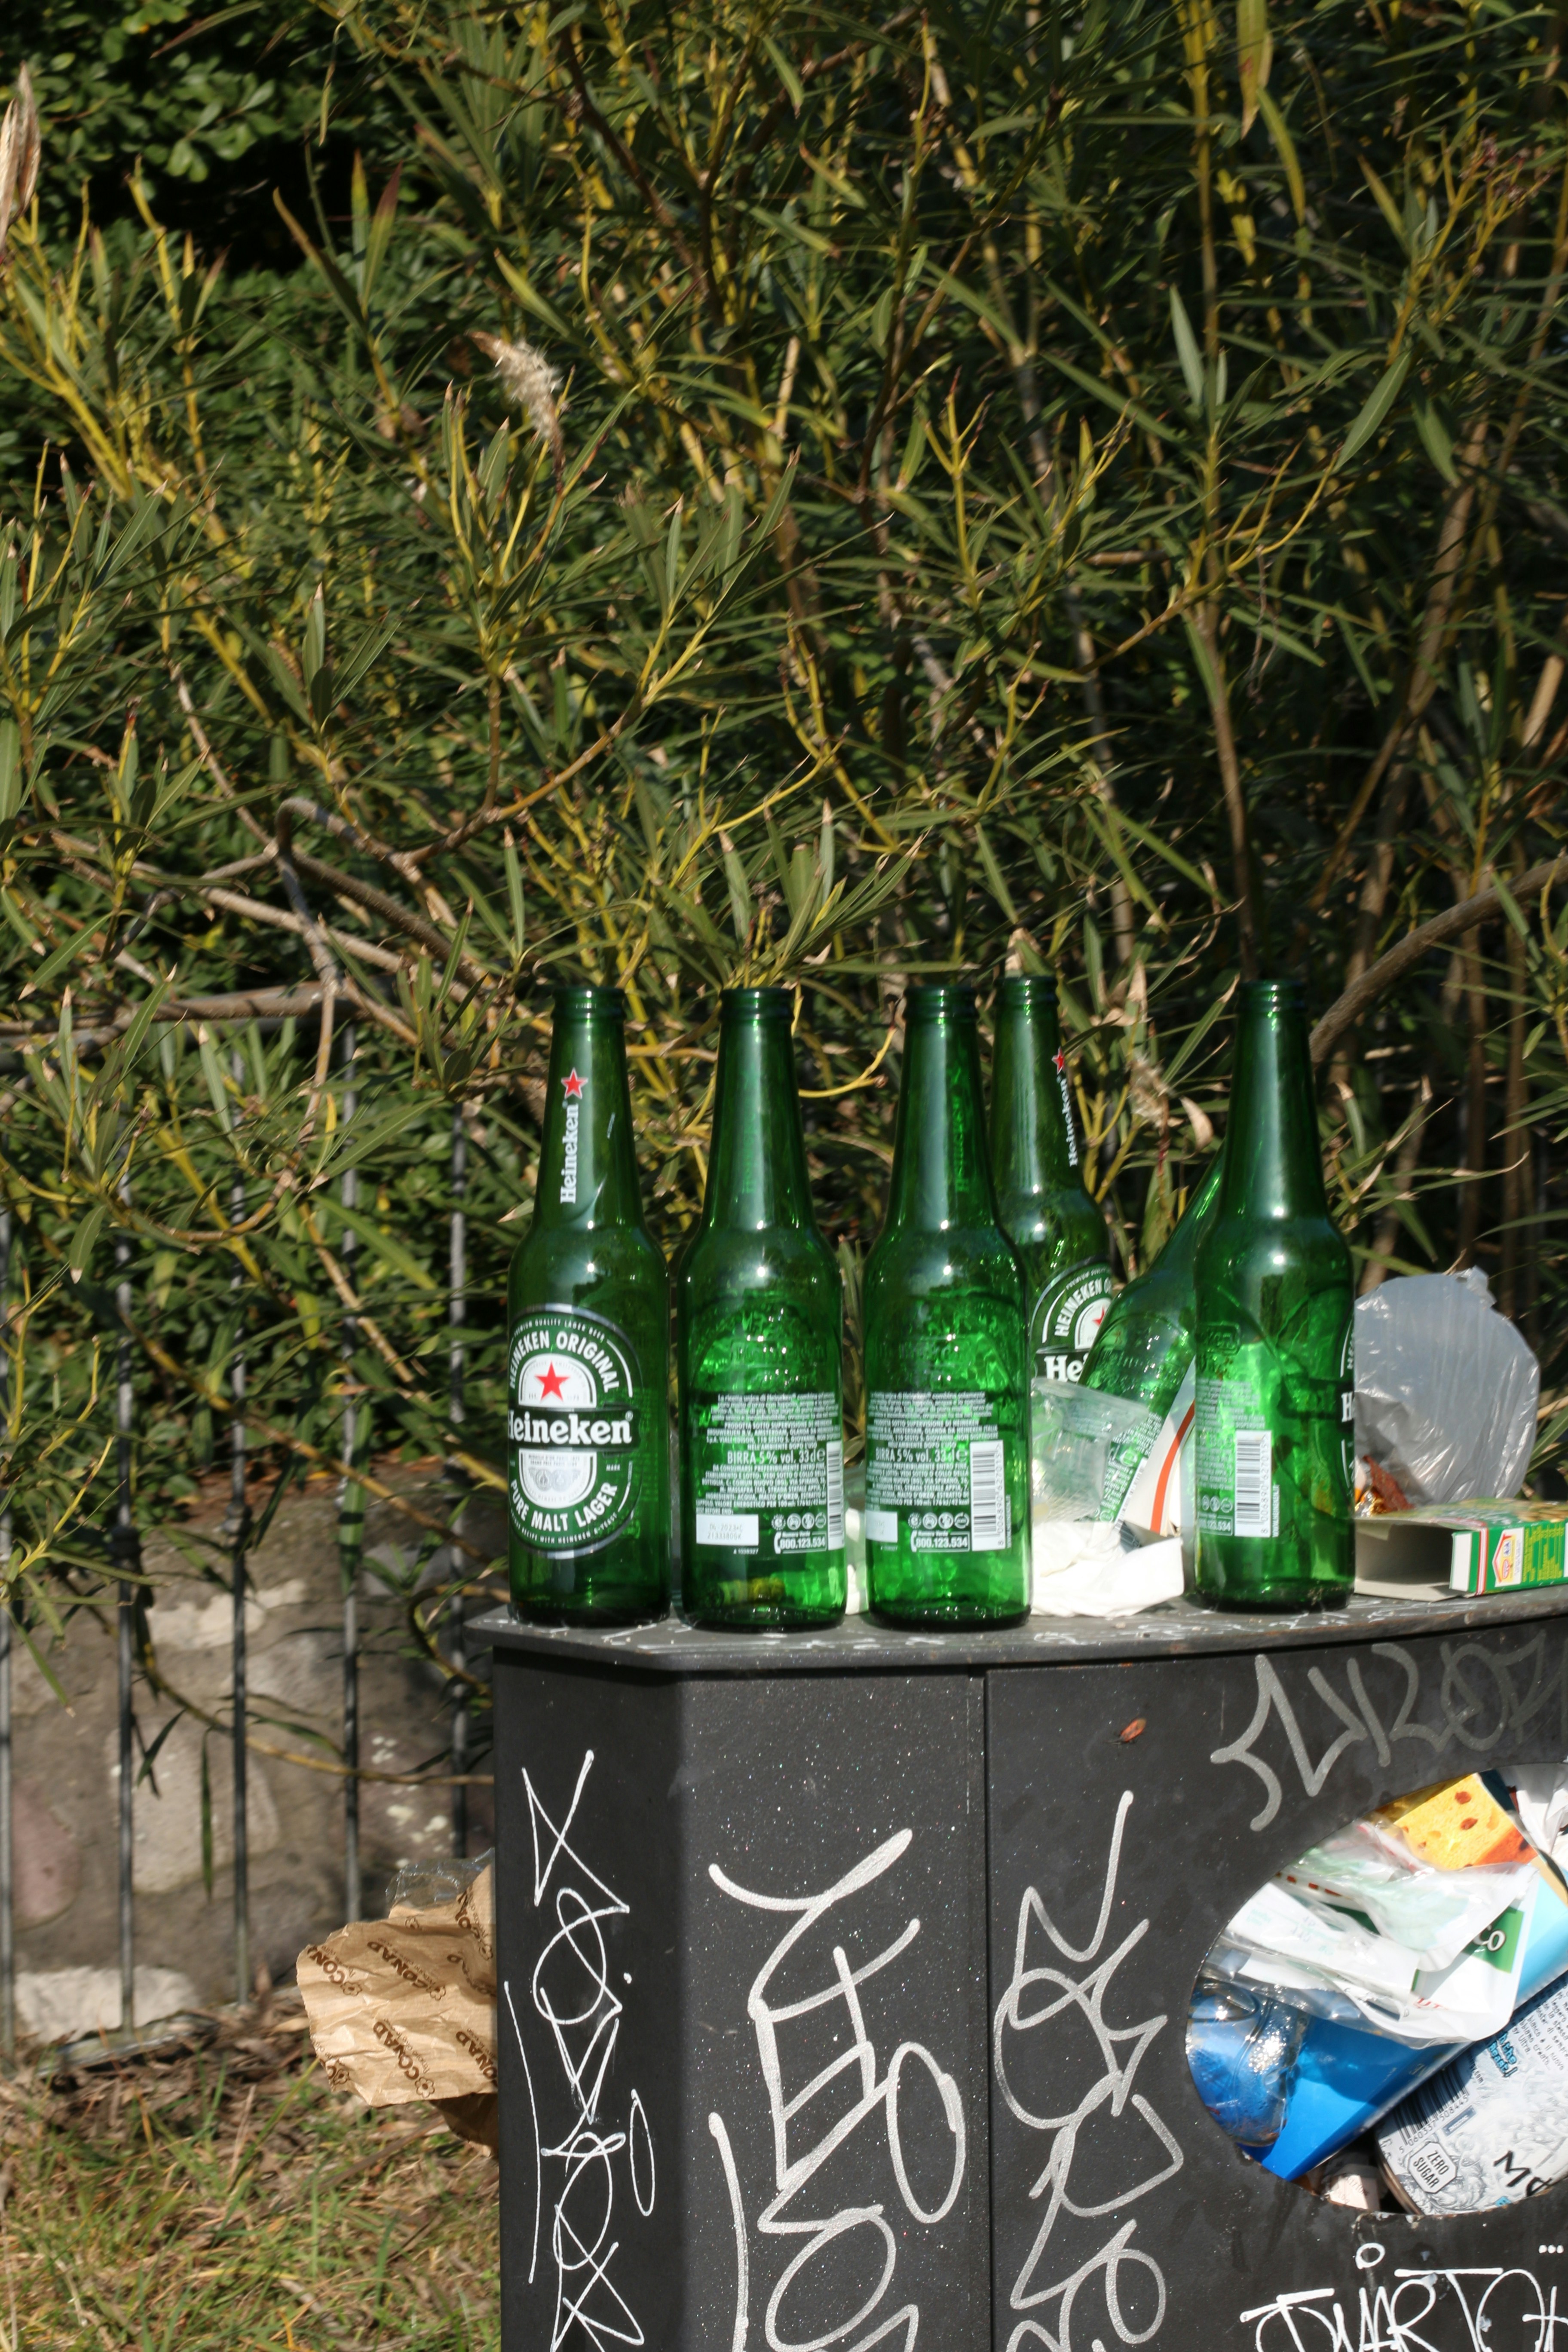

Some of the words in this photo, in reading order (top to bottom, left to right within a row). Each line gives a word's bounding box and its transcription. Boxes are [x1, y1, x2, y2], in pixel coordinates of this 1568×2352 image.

[560, 1103, 579, 1204] Heineken
[1054, 1278, 1102, 1337] HEINEKEN
[535, 1318, 561, 1327] QUALITY
[564, 1320, 586, 1332] LAGER
[589, 1326, 605, 1342] BEER
[509, 1330, 550, 1390] HEINEKEN
[556, 1331, 620, 1393] ORIGINAL
[727, 1450, 756, 1464] BIRRA
[789, 1442, 804, 1450] DOPO
[876, 1448, 895, 1461] BIRRA
[799, 1470, 814, 1478] COLLO
[511, 1479, 529, 1521] PURE
[531, 1510, 568, 1532] MALT
[574, 1482, 618, 1528] LAGER
[540, 1535, 555, 1544] WITH
[557, 1530, 591, 1544] HEINEKEN
[780, 1537, 826, 1550] 800.123.534
[916, 1536, 968, 1549] 800.123.534
[367, 1941, 429, 1990] CONAD
[1550, 1998, 1567, 2023] leggero
[373, 2021, 420, 2080] CONAD
[1502, 2041, 1517, 2065] the
[1527, 2014, 1541, 2037] bianco
[1550, 2052, 1564, 2071] nuovo
[1407, 2119, 1437, 2147] 060337
[1439, 2095, 1469, 2122] 508445
[1412, 2156, 1440, 2189] SUGAR
[1427, 2150, 1450, 2176] ZERO
